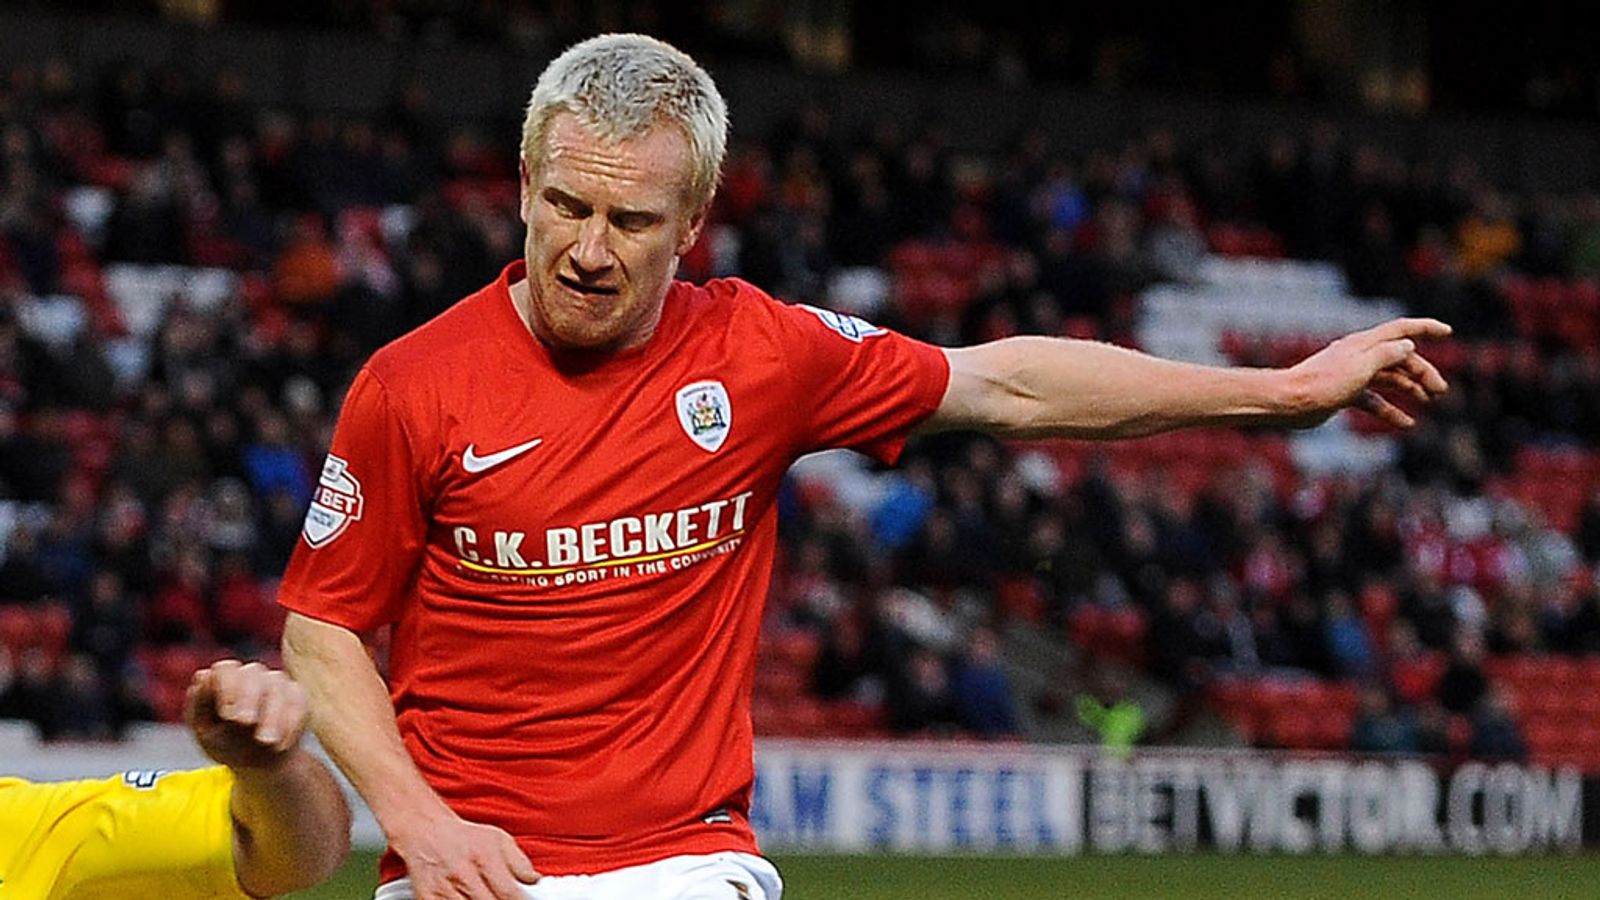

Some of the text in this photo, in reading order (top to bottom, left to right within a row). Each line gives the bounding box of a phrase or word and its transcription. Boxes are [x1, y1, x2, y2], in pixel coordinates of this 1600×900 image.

[320, 487, 357, 514] BET
[453, 490, 753, 568] C.K.BECKETT
[554, 568, 608, 586] SPORT
[613, 565, 631, 578] IN
[636, 560, 667, 576] THE
[864, 766, 1056, 846] STEEL
[1090, 759, 1583, 853] BETVICTOR.COM
